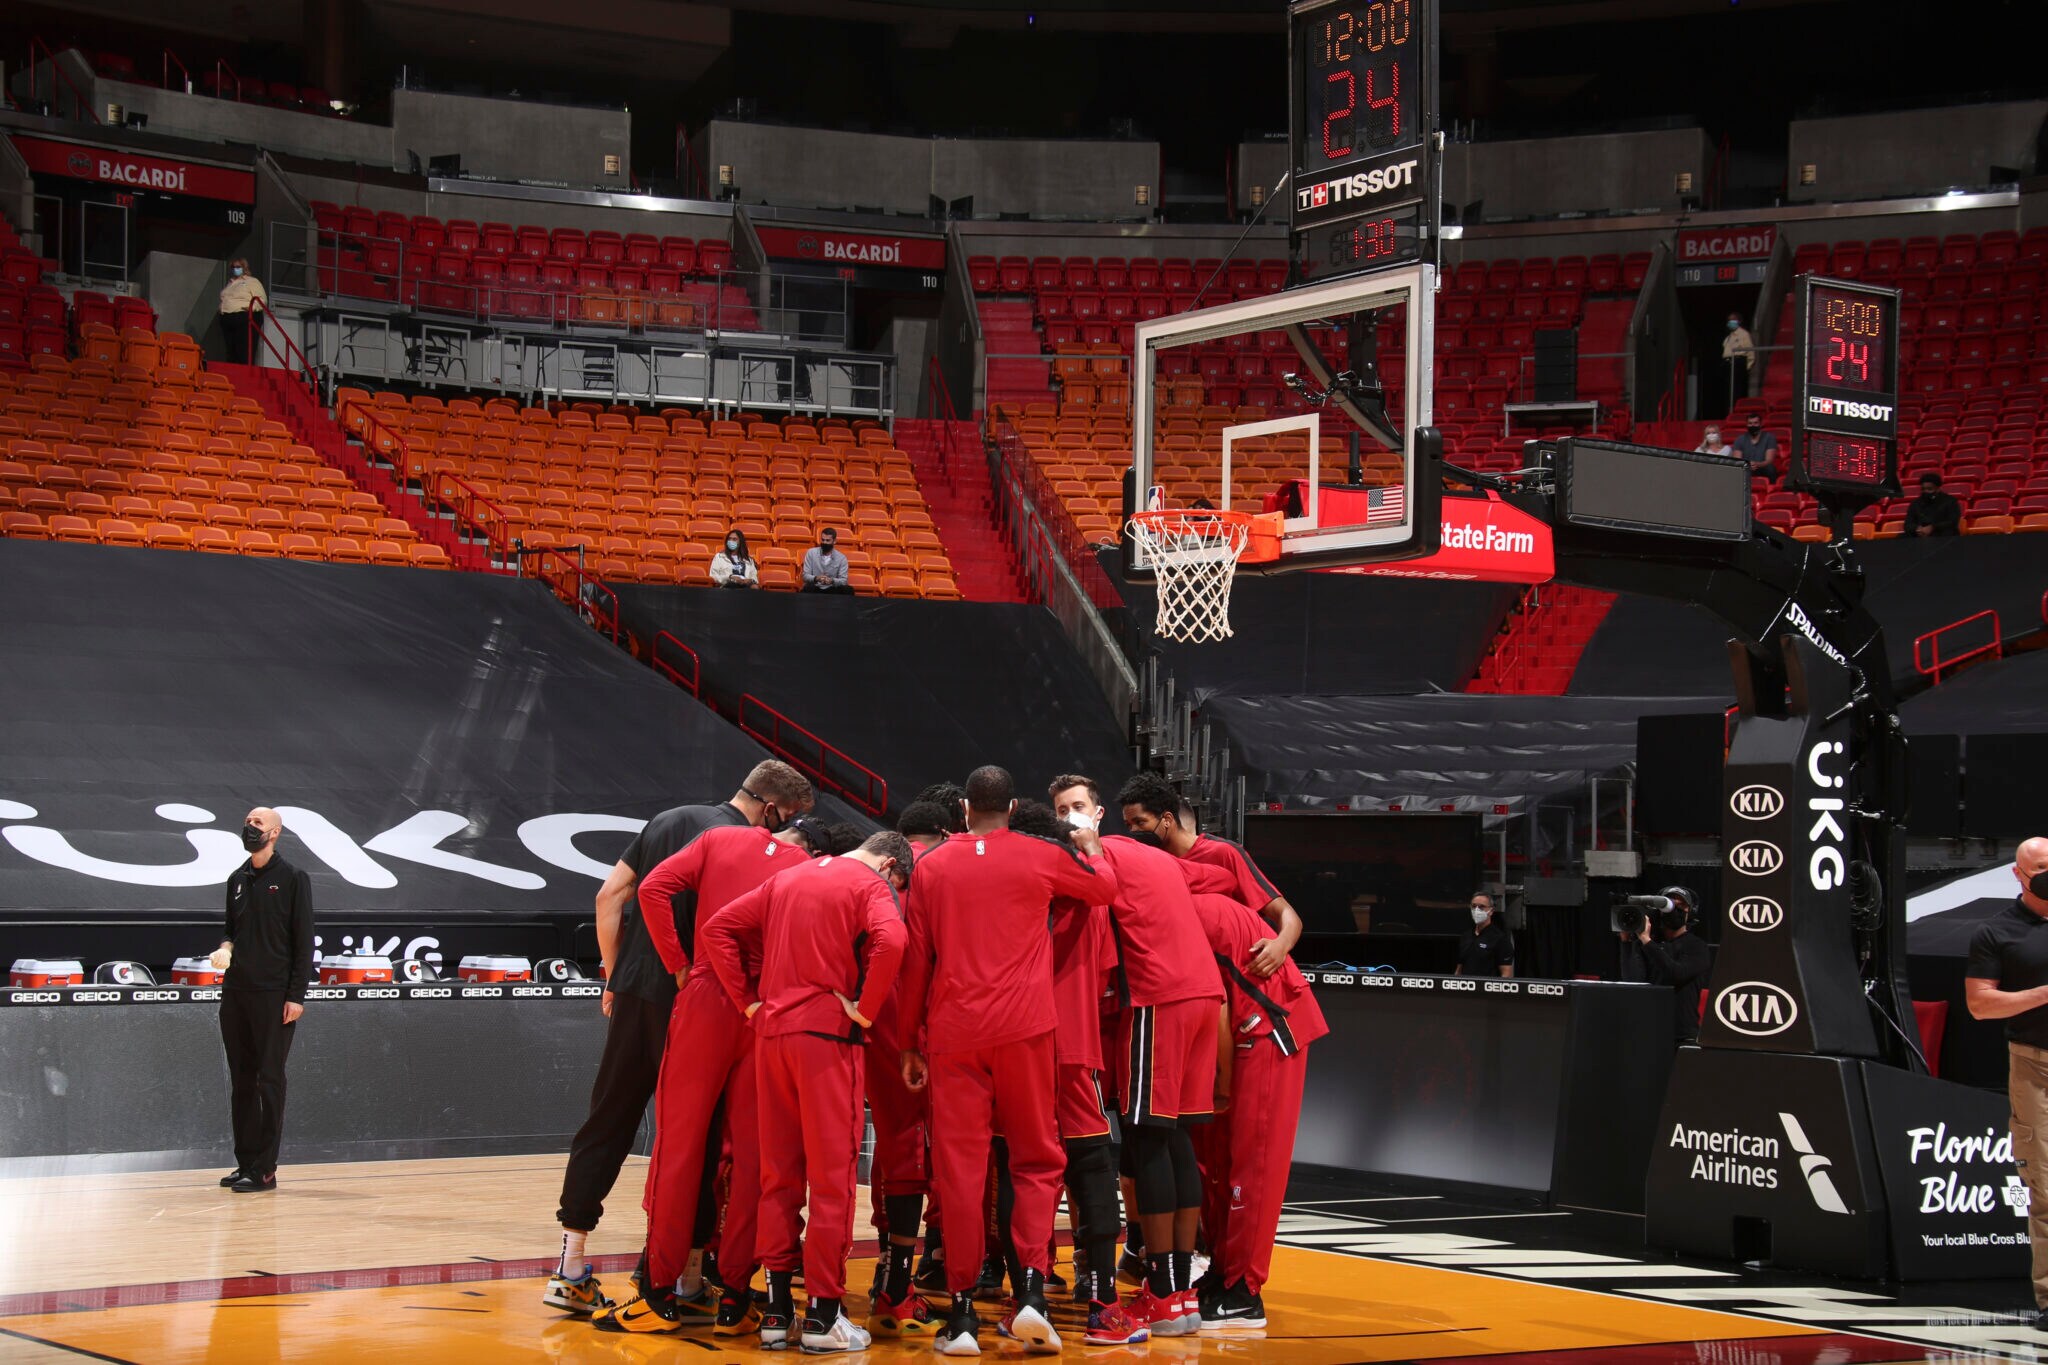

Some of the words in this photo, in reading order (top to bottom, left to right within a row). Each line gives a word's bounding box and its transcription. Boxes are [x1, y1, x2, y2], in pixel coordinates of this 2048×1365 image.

[1326, 0, 1409, 62] 12:00
[1323, 62, 1400, 159] 24
[98, 159, 187, 191] BACARDÍ
[1330, 160, 1418, 202] TISSOT
[228, 210, 245, 224] 109
[824, 241, 901, 263] BACARDÍ
[1353, 217, 1395, 259] 1:30
[1685, 229, 1770, 257] BACARDÍ
[922, 276, 937, 288] 110
[1684, 269, 1701, 281] 110
[1717, 266, 1737, 280] EXIT
[1826, 299, 1880, 337] 12:00
[1826, 336, 1868, 381] 24
[1832, 399, 1893, 422] TISSOT
[1838, 443, 1877, 478] 1:30
[1785, 602, 1846, 665] SPALDING
[1739, 792, 1775, 812] KIA
[1738, 848, 1775, 868] KIA
[1737, 903, 1774, 924] KIA
[11, 992, 61, 1003] GEICO
[72, 991, 121, 1002] GEICO
[132, 990, 180, 1001] GEICO
[191, 990, 222, 1000] GEIC
[357, 988, 400, 999] GEICO
[410, 987, 452, 998] GEICO
[461, 987, 503, 997] GEICO
[512, 986, 553, 997] GEICO
[562, 986, 602, 996] GEICO
[1322, 974, 1354, 985] GEICO
[1361, 975, 1394, 987] GEICO
[1401, 977, 1434, 989] GEICO
[1442, 979, 1476, 991] GEICO
[1484, 981, 1519, 993] GEICO
[1527, 983, 1564, 996] GEICO
[1728, 992, 1784, 1025] KIA
[1669, 1123, 1779, 1159] American
[1906, 1121, 2015, 1164] Florid
[1690, 1154, 1778, 1189] Airlines
[1919, 1170, 1996, 1214] Blue
[1921, 1234, 1944, 1247] Your
[1944, 1233, 1967, 1246] local
[1967, 1232, 1989, 1245] Blue
[1989, 1232, 2015, 1245] Cross
